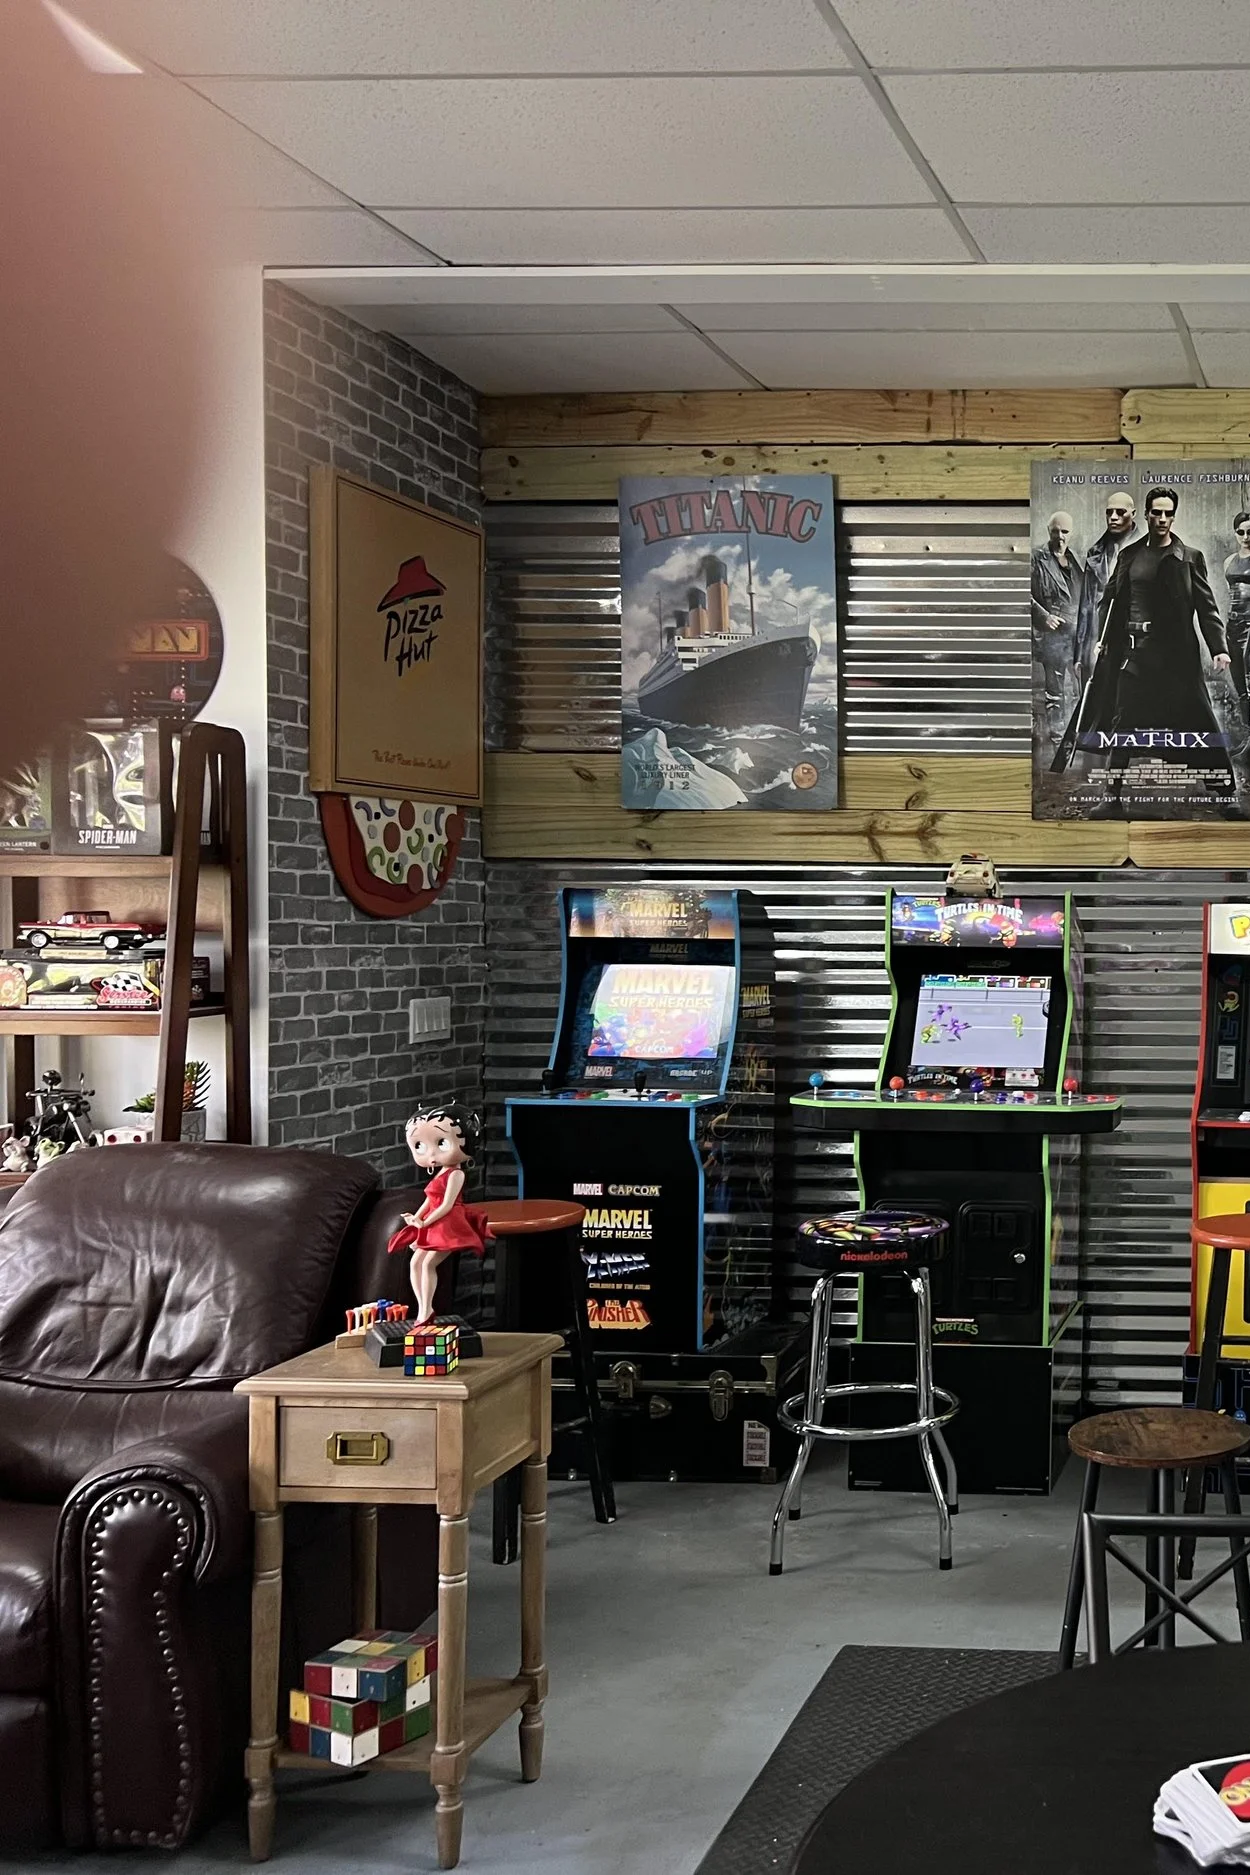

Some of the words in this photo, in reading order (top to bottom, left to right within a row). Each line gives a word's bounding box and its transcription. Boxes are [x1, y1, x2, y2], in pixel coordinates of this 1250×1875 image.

[1052, 475, 1085, 484] KEANU
[1090, 475, 1129, 484] REEVES
[1141, 475, 1193, 484] LAURENCE
[629, 489, 823, 546] TITANIC
[384, 604, 444, 662] Pizza
[396, 630, 439, 677] Hut
[1097, 731, 1210, 749] MATRIX
[664, 763, 695, 772] LARGEST
[641, 771, 669, 780] LUXURY
[669, 771, 690, 780] LINER
[78, 828, 137, 845] SPIDER-MAN
[629, 902, 688, 918] MARVEL
[935, 903, 979, 922] TURTLES
[983, 903, 995, 914] IN
[996, 904, 1024, 925] TIME
[629, 919, 659, 927] SUPER
[660, 919, 688, 927] HEROES
[612, 968, 715, 995] MARVEL
[99, 986, 153, 1004] Service
[608, 996, 657, 1009] SUPER
[659, 996, 714, 1009] HEROES
[584, 1065, 613, 1077] MARVEL
[908, 1072, 934, 1085] TURTLES
[942, 1074, 958, 1085] TIME
[573, 1183, 603, 1196] MARVEL
[608, 1184, 661, 1197] CAPCOM
[582, 1208, 653, 1230] MARVEL
[582, 1229, 613, 1239] SUPER
[615, 1229, 653, 1240] HEROES
[839, 1250, 908, 1262] nickelodeon
[932, 1322, 979, 1336] TURTLES
